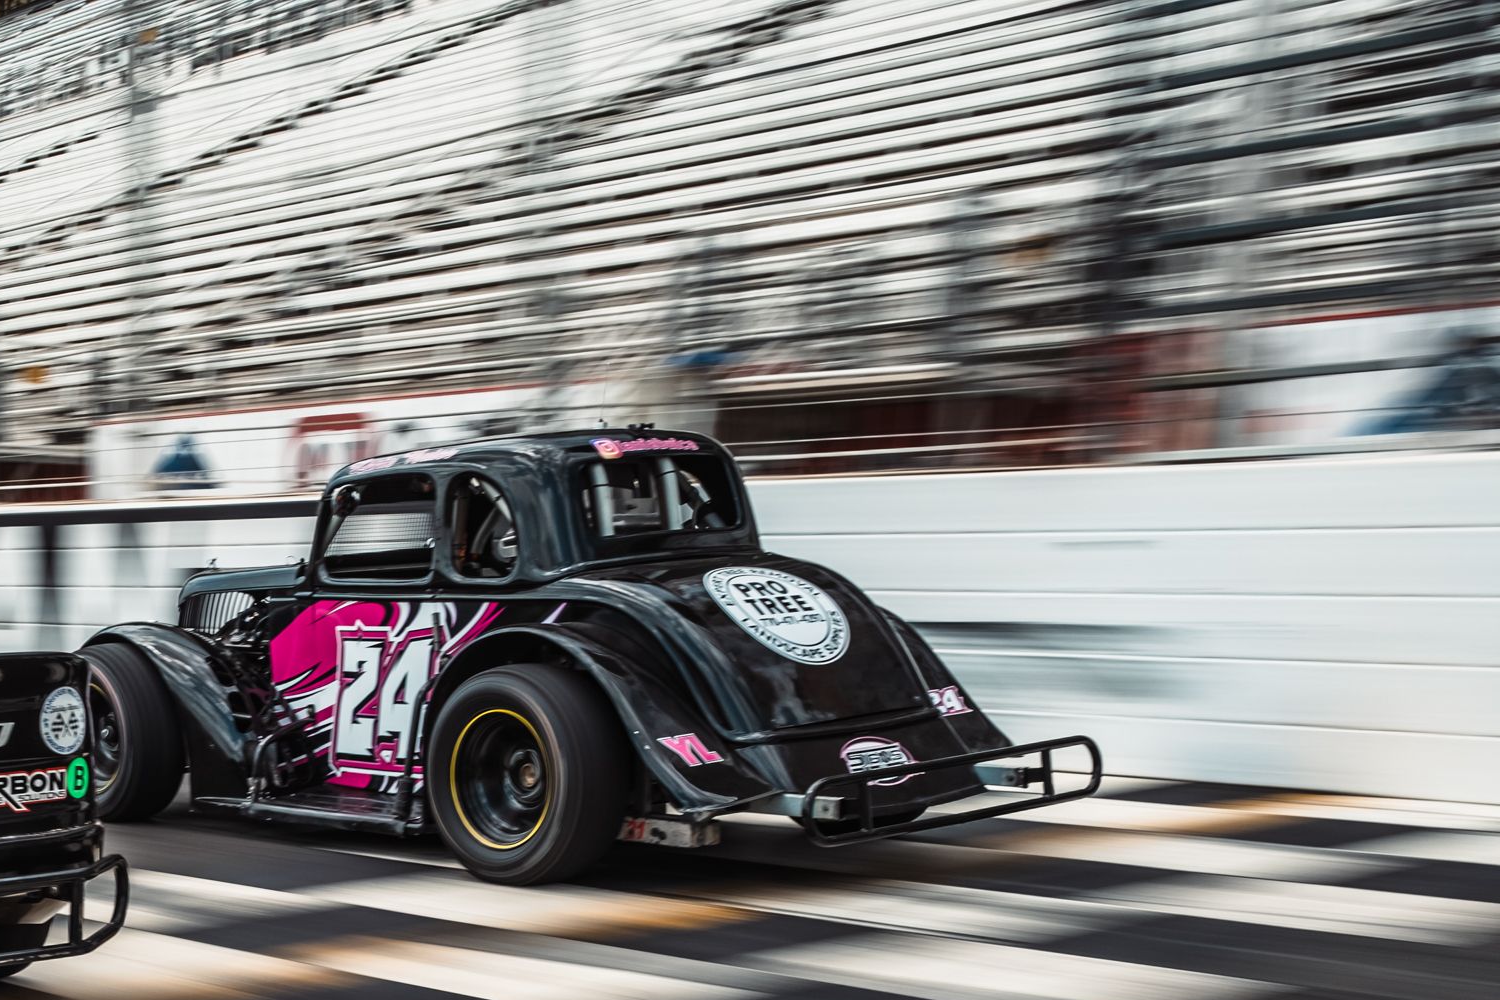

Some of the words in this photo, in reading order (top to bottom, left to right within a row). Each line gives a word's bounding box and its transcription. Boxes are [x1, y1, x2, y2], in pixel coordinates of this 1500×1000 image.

[732, 580, 789, 598] PRO
[743, 594, 815, 616] TREE
[332, 630, 430, 766] 24
[656, 732, 725, 768] YL
[73, 765, 86, 791] B
